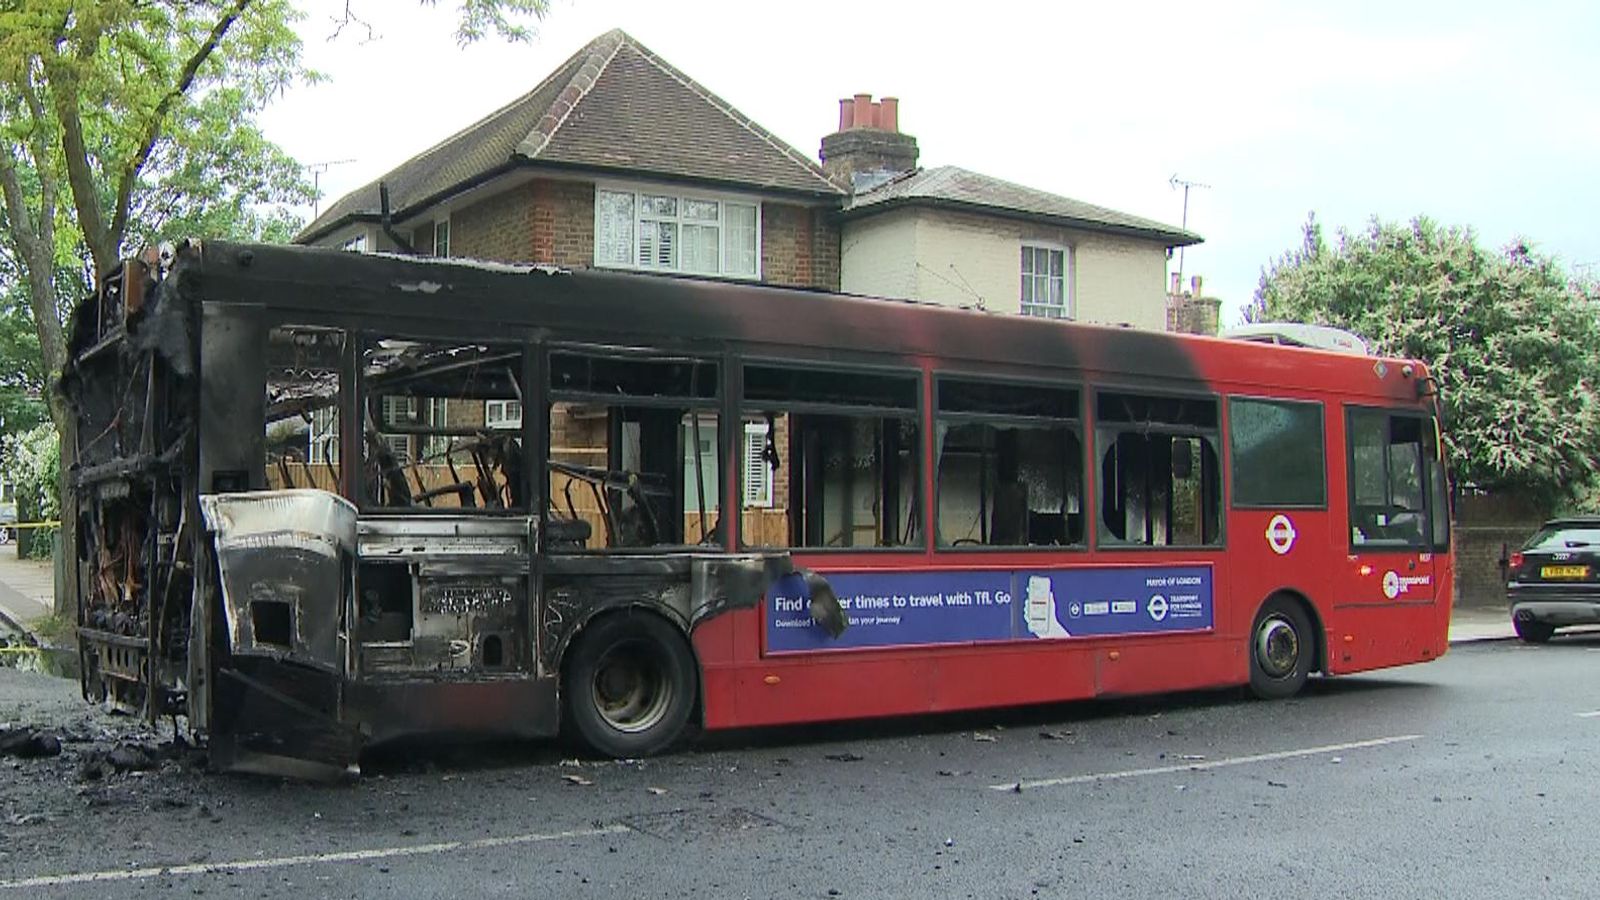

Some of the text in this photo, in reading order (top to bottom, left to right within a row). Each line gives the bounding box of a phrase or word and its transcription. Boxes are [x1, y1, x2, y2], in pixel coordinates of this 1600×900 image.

[1146, 576, 1202, 587] MAYOR OF LONDON
[1399, 576, 1430, 585] TRANSPORT
[775, 596, 804, 612] Find
[855, 594, 890, 610] times
[893, 594, 907, 608] to
[909, 593, 944, 607] travel
[945, 591, 972, 606] with
[974, 591, 993, 605] TfL
[995, 590, 1011, 605] Go
[775, 618, 811, 628] Download
[860, 616, 876, 627] your
[876, 615, 901, 626] journey
